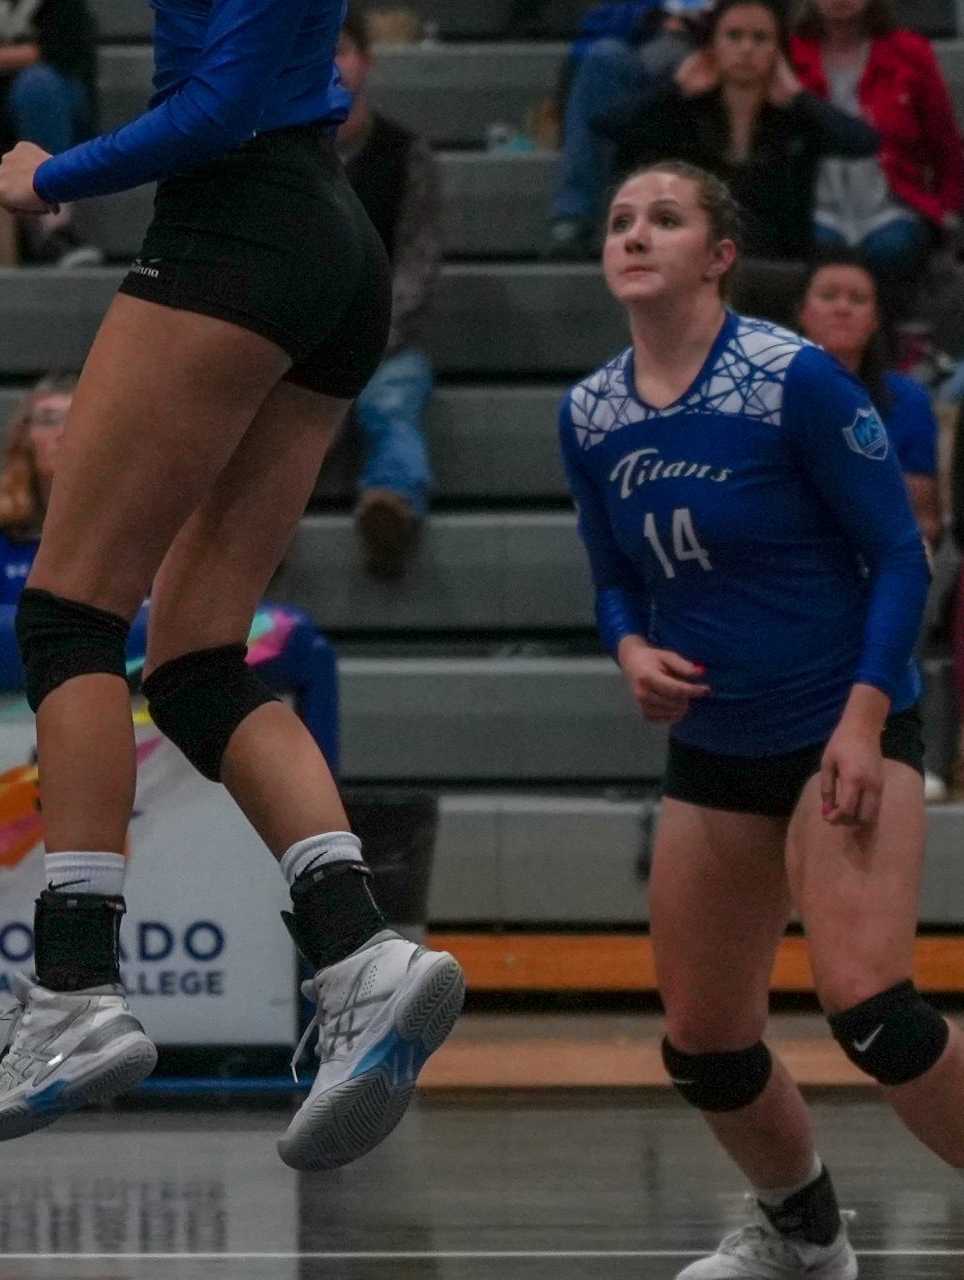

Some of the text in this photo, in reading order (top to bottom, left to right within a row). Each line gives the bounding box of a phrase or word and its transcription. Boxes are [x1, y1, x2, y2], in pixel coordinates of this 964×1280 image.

[609, 447, 733, 500] Titans
[643, 508, 713, 579] 14
[125, 970, 224, 997] LEGE
